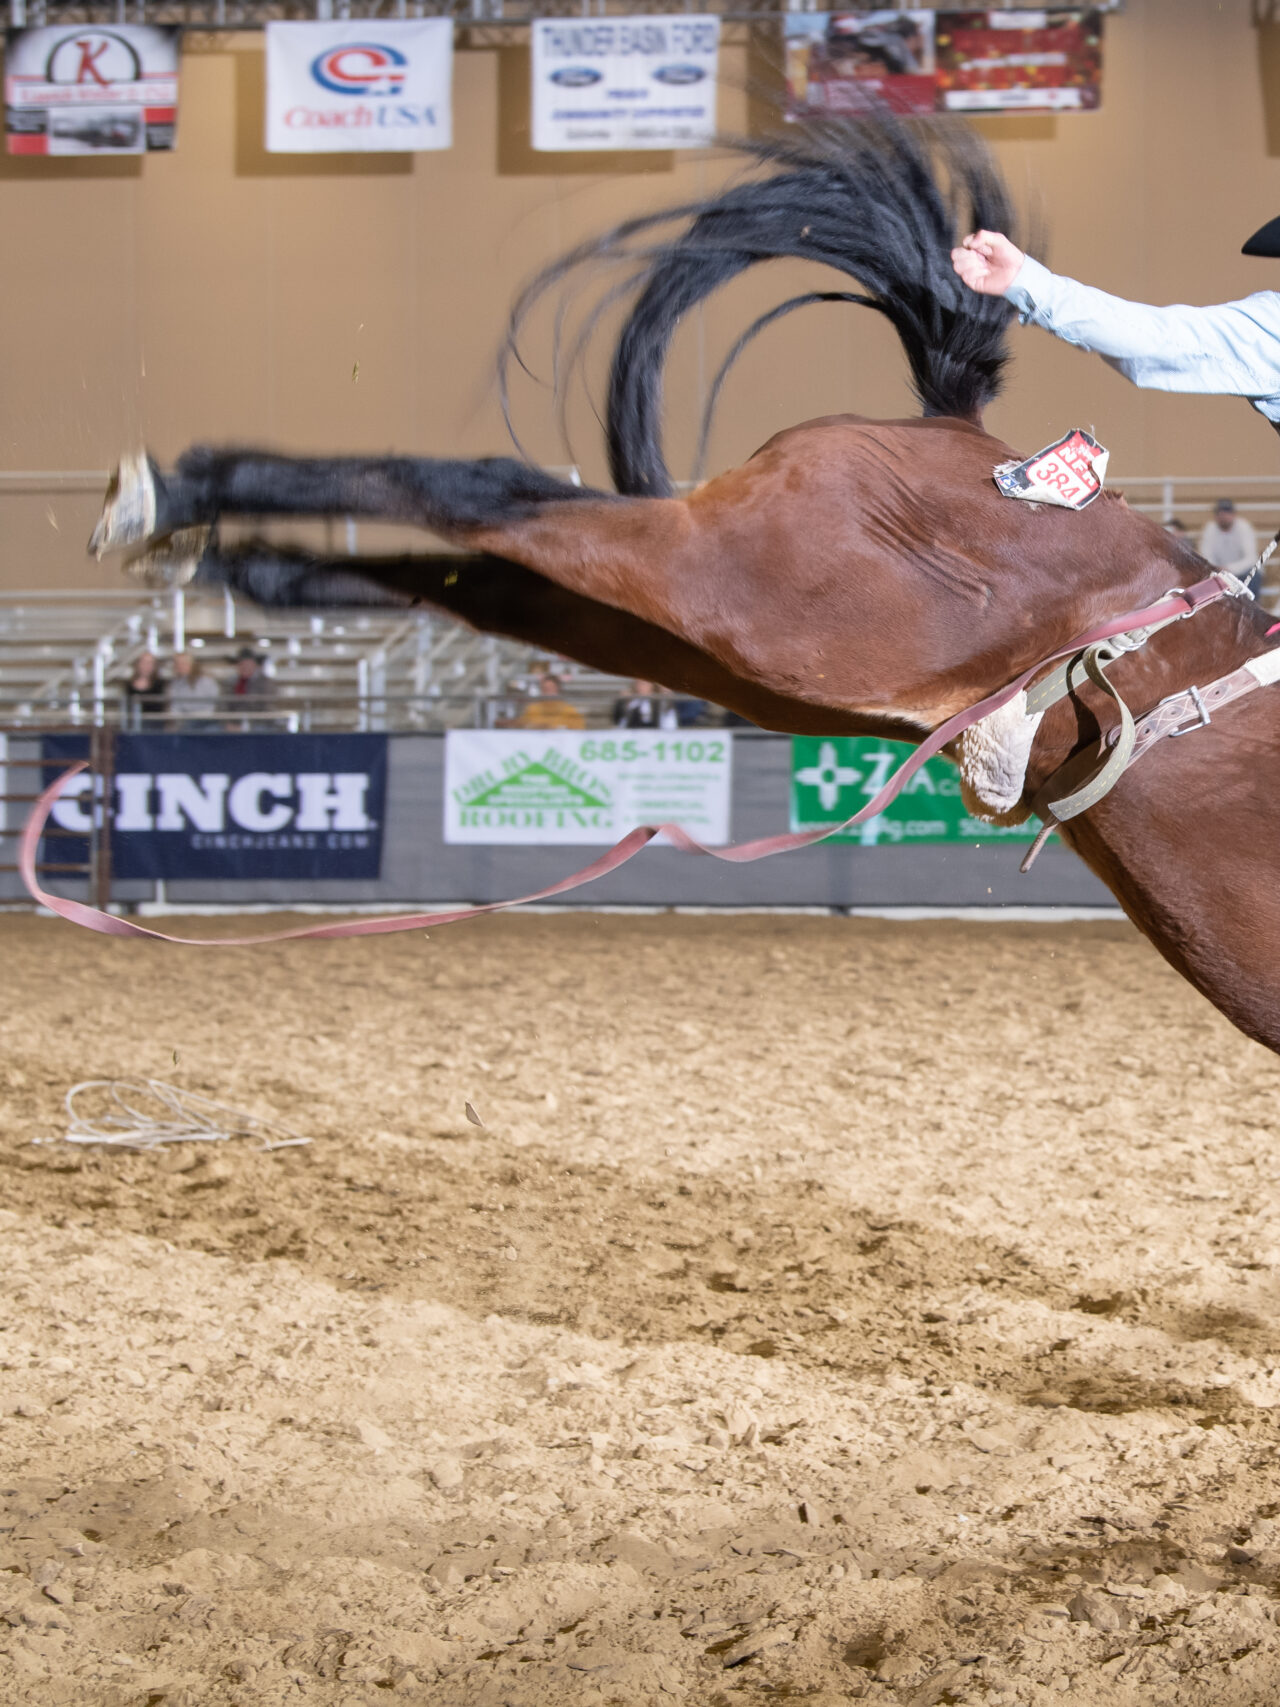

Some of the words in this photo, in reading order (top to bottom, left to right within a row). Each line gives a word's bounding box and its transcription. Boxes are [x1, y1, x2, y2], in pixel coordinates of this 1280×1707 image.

[542, 26, 614, 57] THUNDER
[672, 23, 714, 54] FORD
[75, 40, 114, 88] K
[284, 104, 374, 128] Coach
[377, 104, 438, 128] USA
[579, 739, 725, 763] 685-1102
[861, 753, 936, 795] ZA
[51, 773, 370, 831] CINCH
[458, 811, 613, 829] ROOFING
